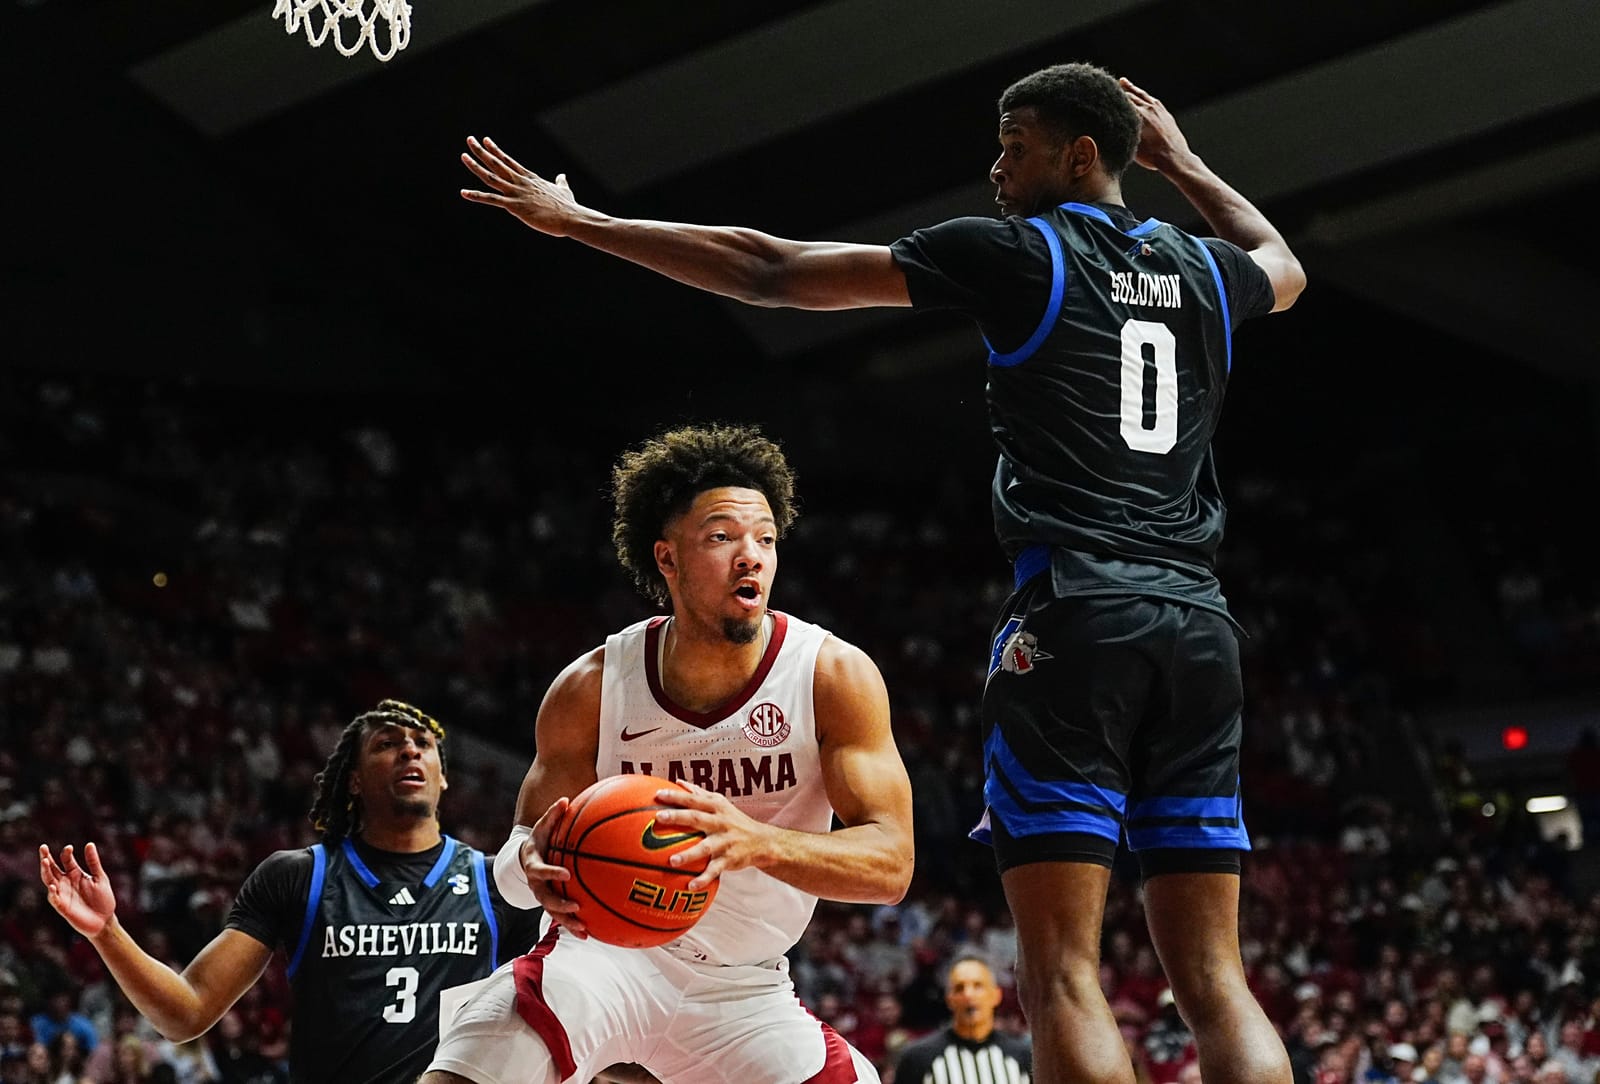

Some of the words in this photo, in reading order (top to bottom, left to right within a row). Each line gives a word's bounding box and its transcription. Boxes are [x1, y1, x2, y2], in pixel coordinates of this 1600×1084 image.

[1110, 270, 1182, 309] SOLOMON
[1120, 318, 1178, 455] 0
[751, 704, 783, 735] SEC
[629, 878, 709, 913] ELITE
[321, 922, 480, 958] ASHEVILLE
[382, 967, 420, 1024] 3
